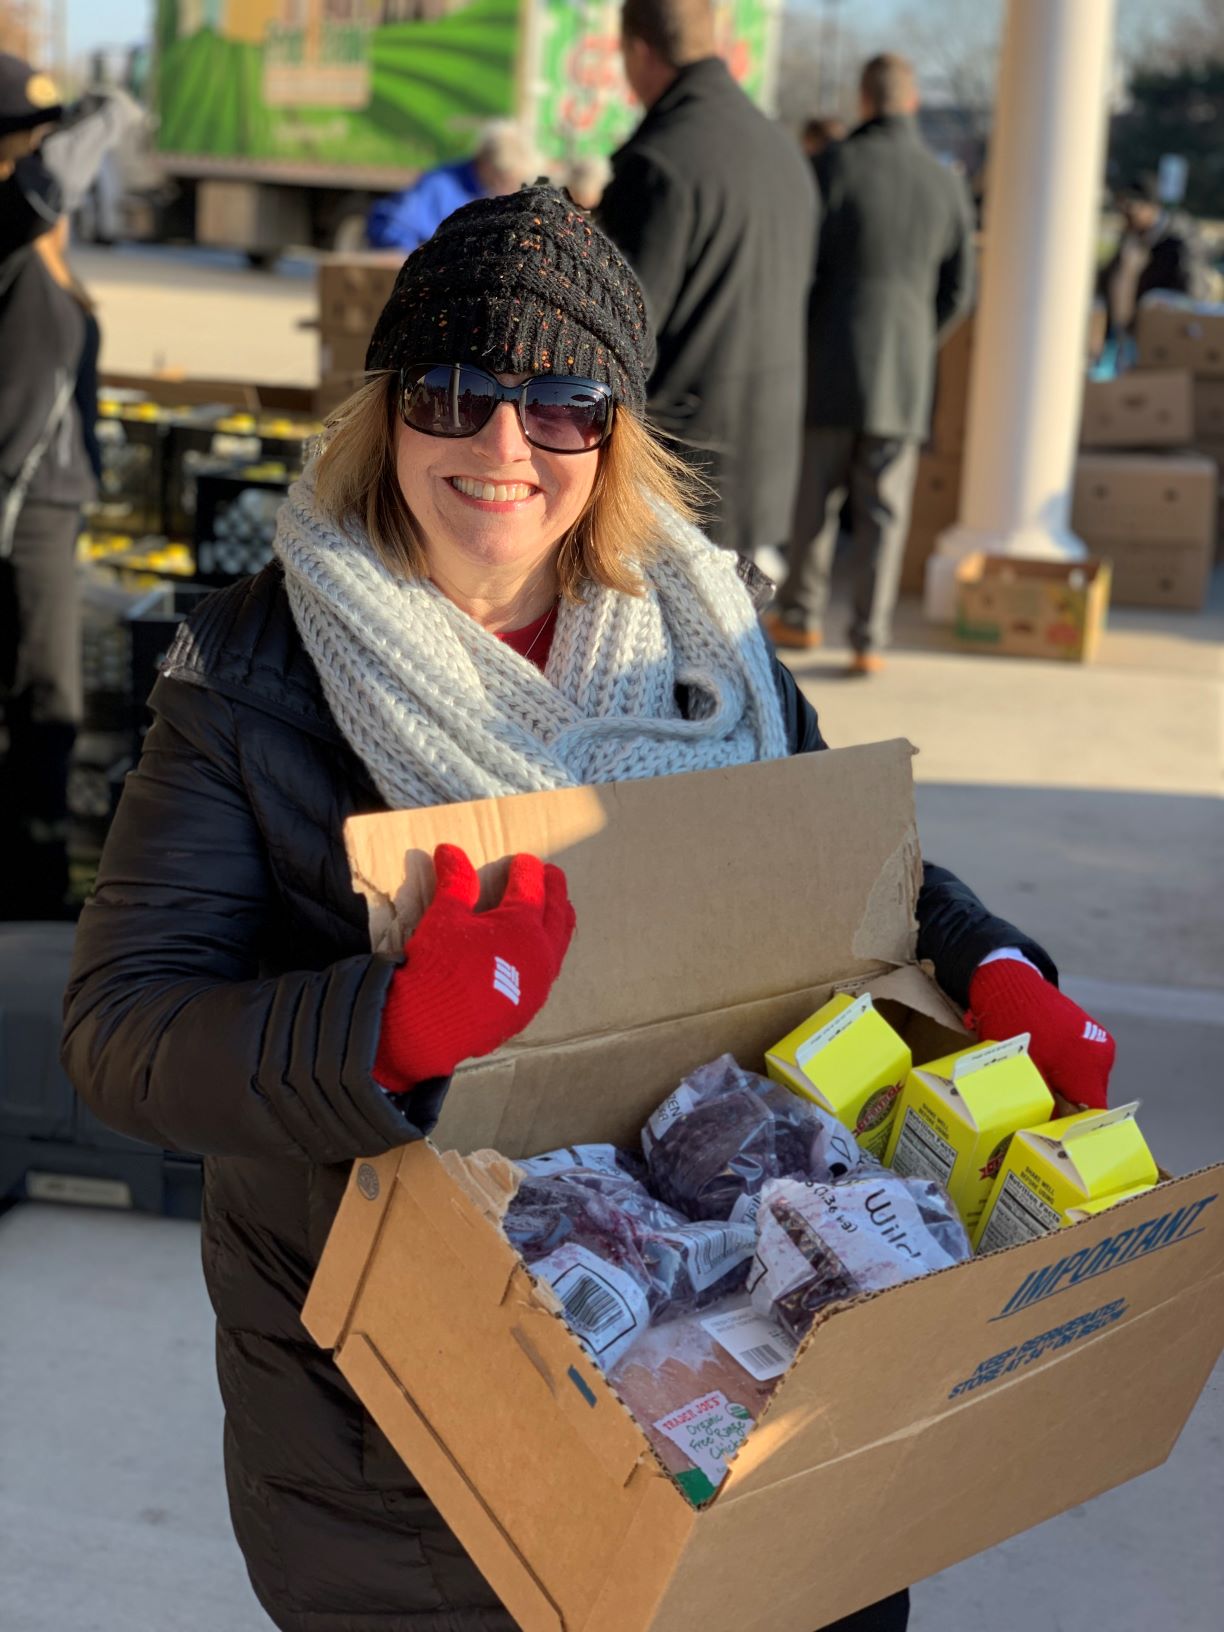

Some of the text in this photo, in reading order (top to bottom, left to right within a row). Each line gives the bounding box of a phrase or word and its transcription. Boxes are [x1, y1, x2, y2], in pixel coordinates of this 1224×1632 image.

[1008, 1173, 1039, 1204] Nutrition
[1038, 1201, 1061, 1224] Facts
[1001, 1193, 1219, 1316] IMPORTANT
[662, 1409, 697, 1431] TRADER
[686, 1412, 724, 1436] Organic
[689, 1420, 746, 1453] Free Range
[709, 1438, 743, 1460] Chick
